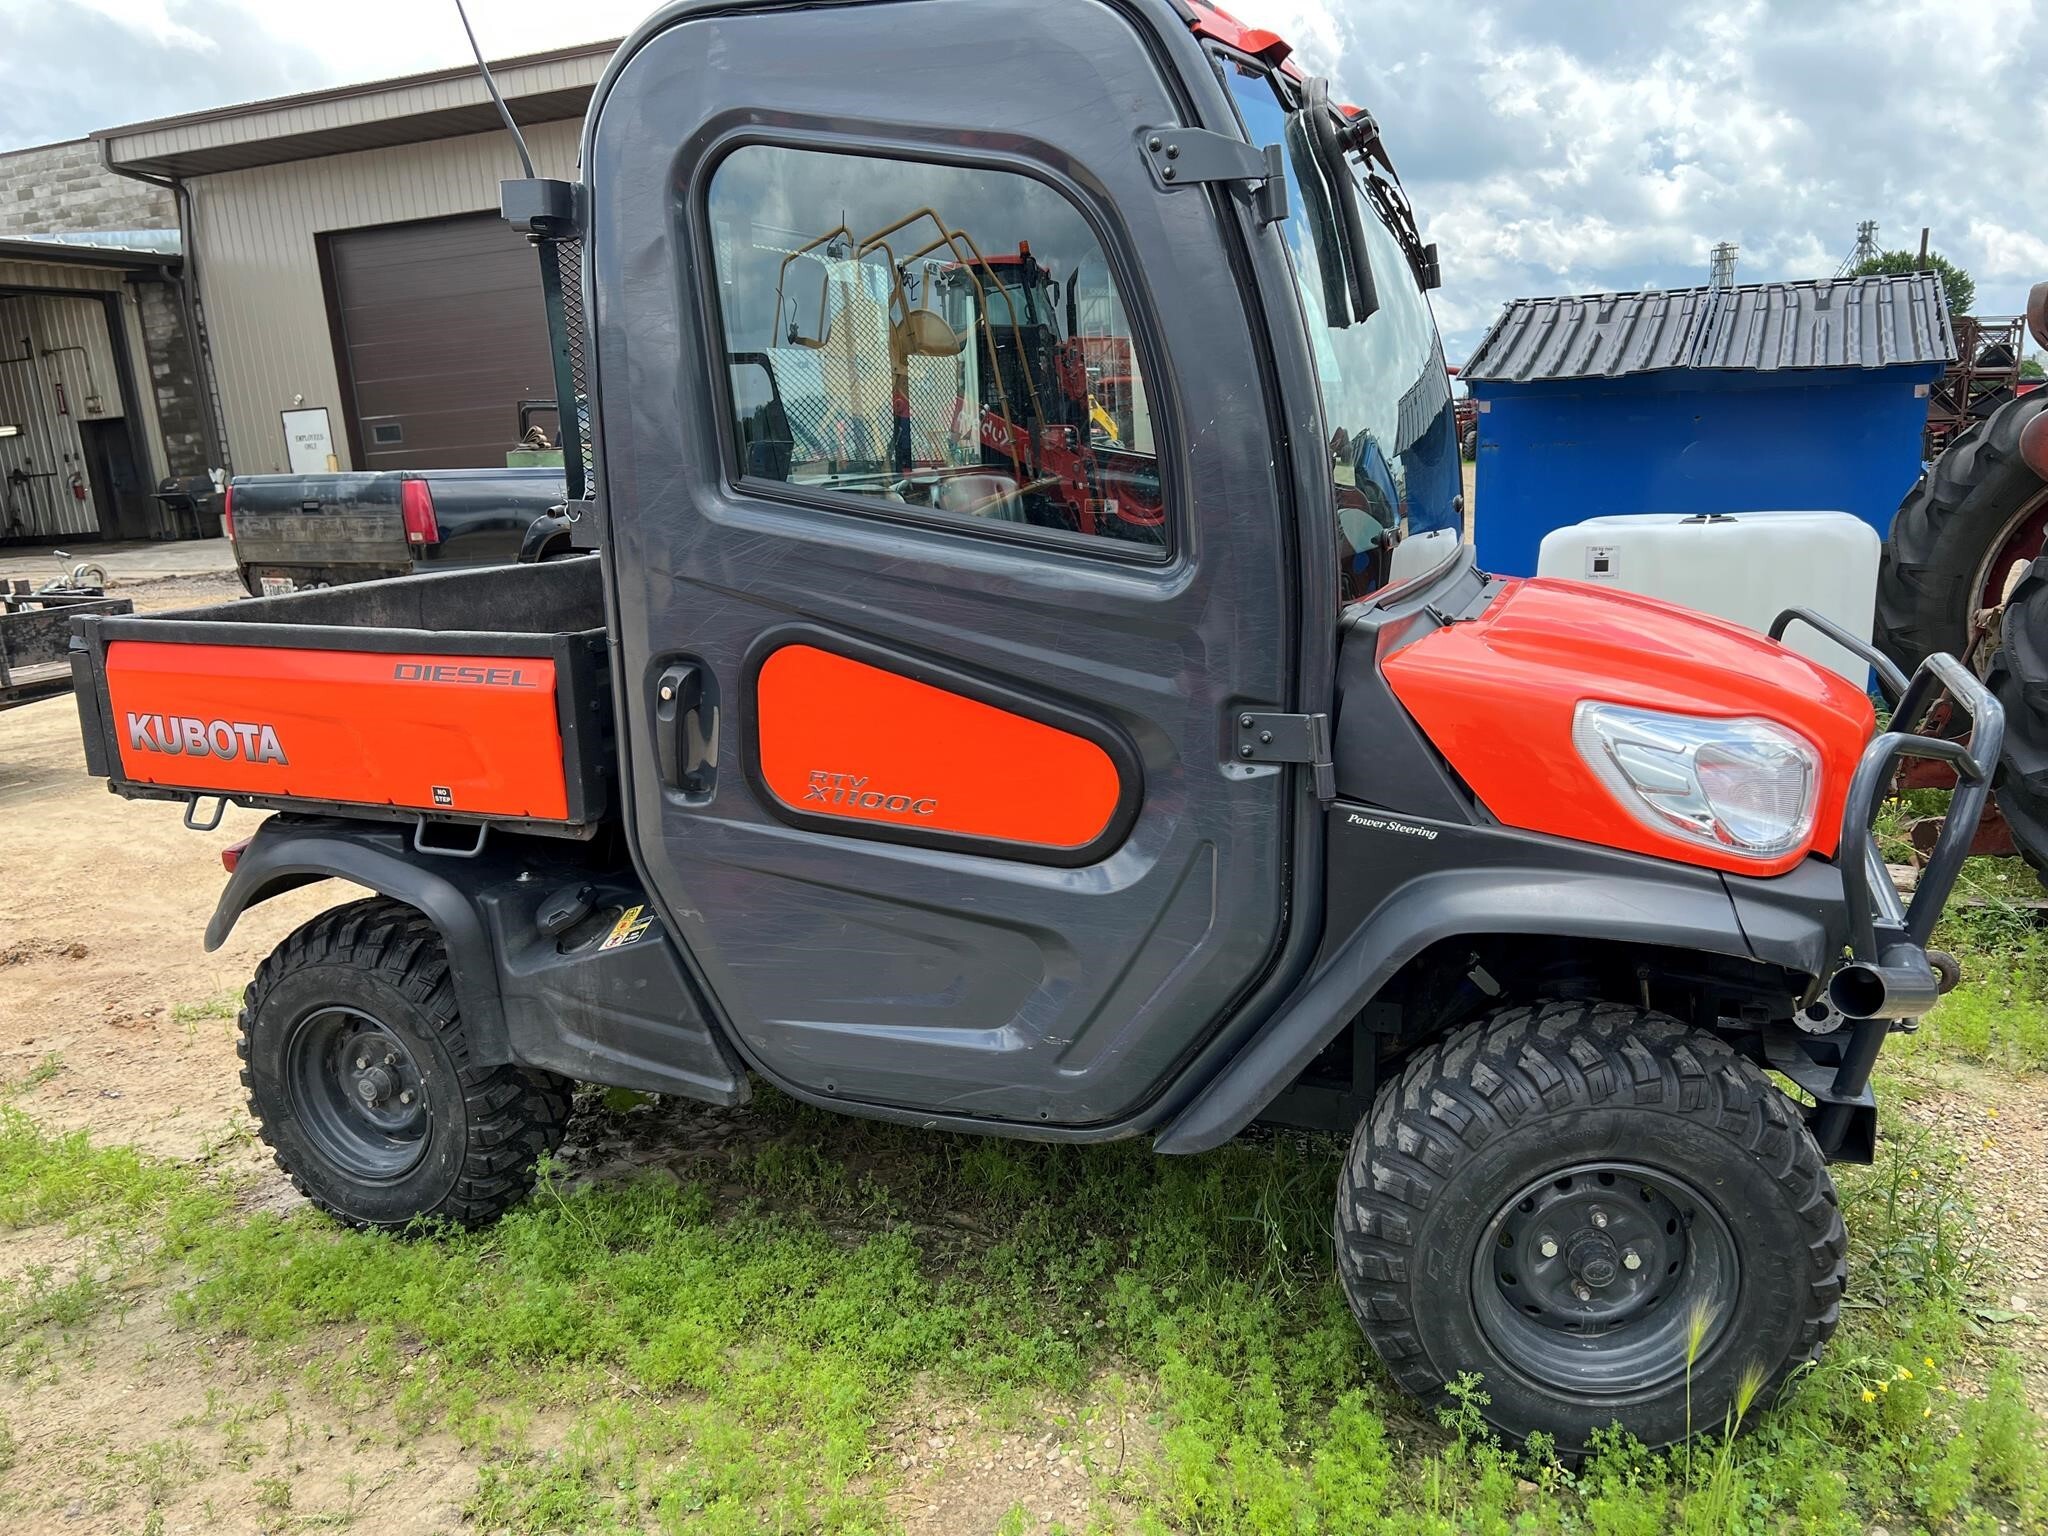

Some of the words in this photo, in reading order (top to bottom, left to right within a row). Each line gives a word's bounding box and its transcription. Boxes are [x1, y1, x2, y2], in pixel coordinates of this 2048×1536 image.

[393, 662, 537, 688] DIESEL
[126, 711, 289, 766] KUBOTA
[808, 770, 869, 788] RTV
[802, 784, 937, 816] X1100C
[1347, 813, 1387, 829] Power
[1386, 821, 1438, 840] Steering
